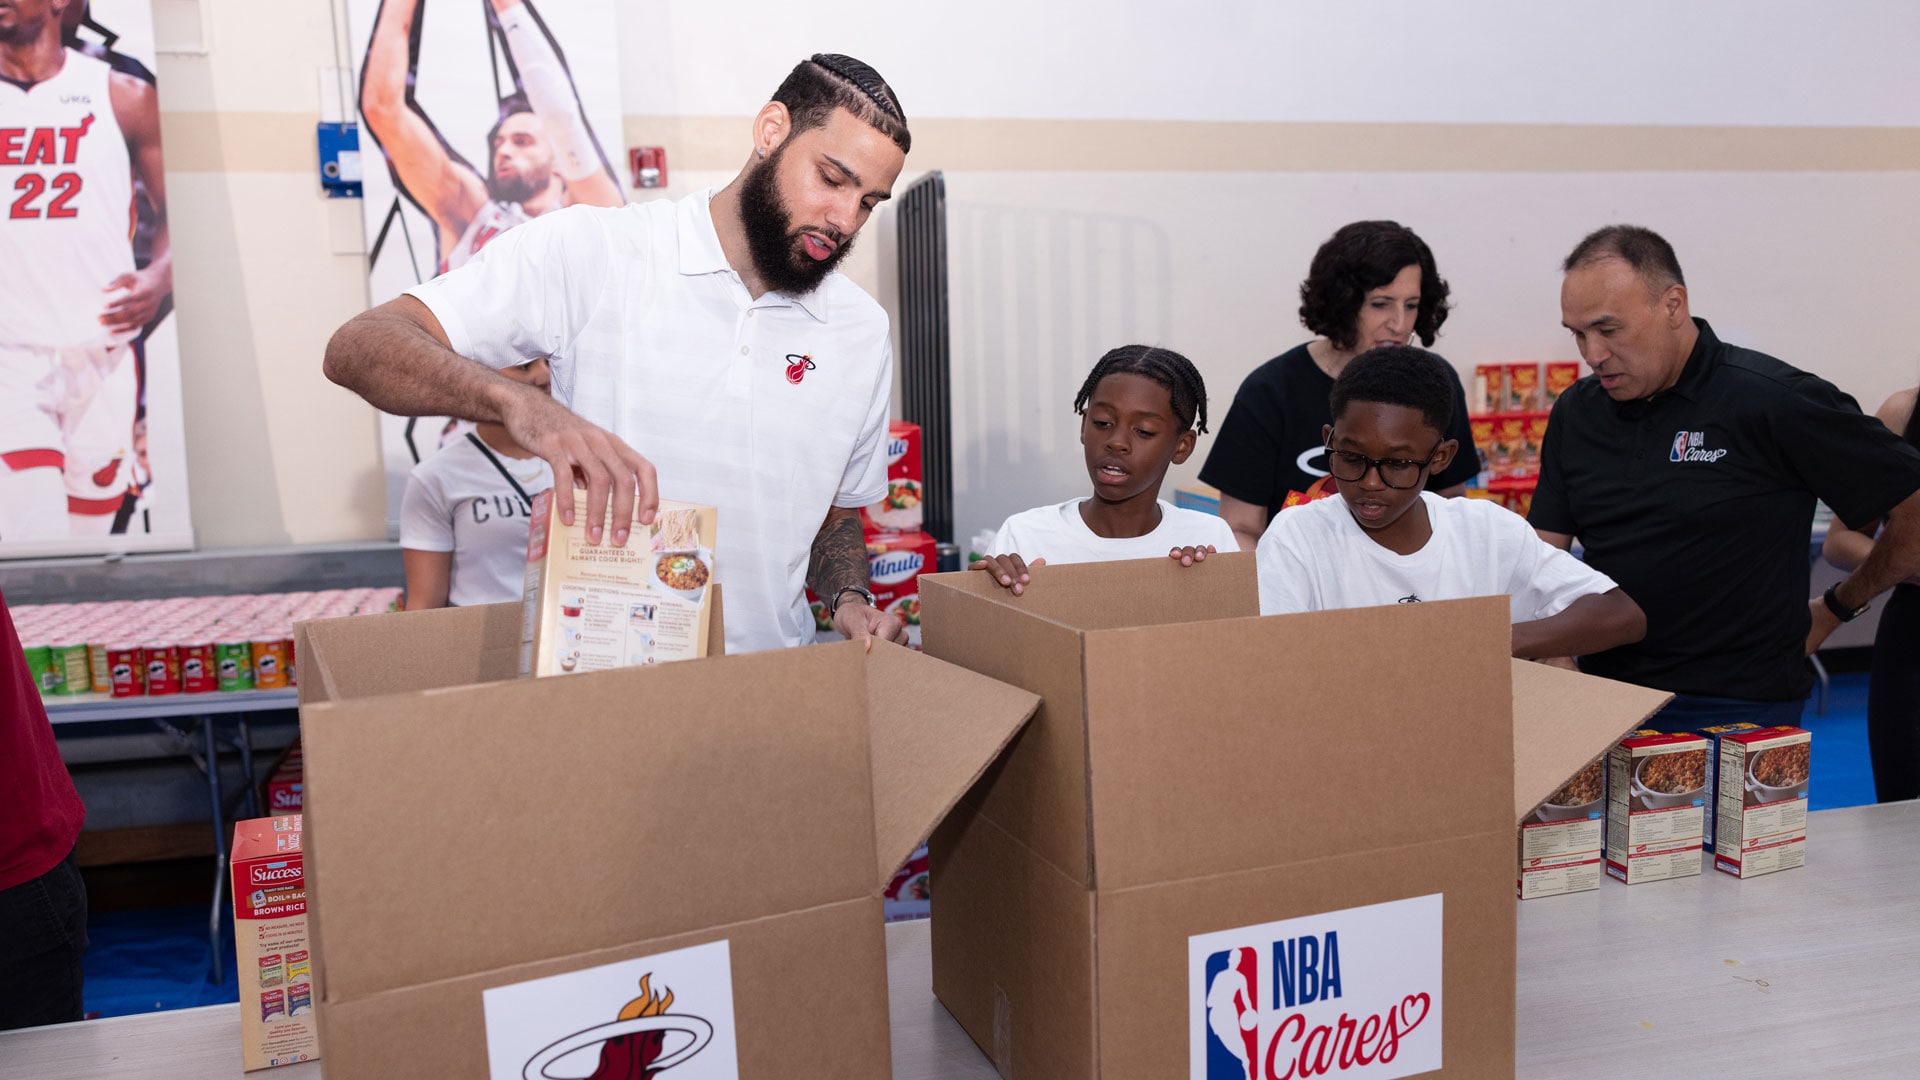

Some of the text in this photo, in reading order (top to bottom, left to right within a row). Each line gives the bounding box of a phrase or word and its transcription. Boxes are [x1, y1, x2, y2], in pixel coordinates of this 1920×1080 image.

[9, 172, 83, 219] 22
[1687, 431, 1704, 447] NBA
[1683, 447, 1719, 463] Cares
[580, 548, 624, 556] GUARANTEED
[870, 554, 923, 577] Minute
[253, 867, 302, 882] Success
[268, 894, 285, 902] BOIL
[254, 903, 305, 916] BROWN RICE
[1273, 930, 1342, 1010] NBA
[1265, 1004, 1399, 1080] Cares
